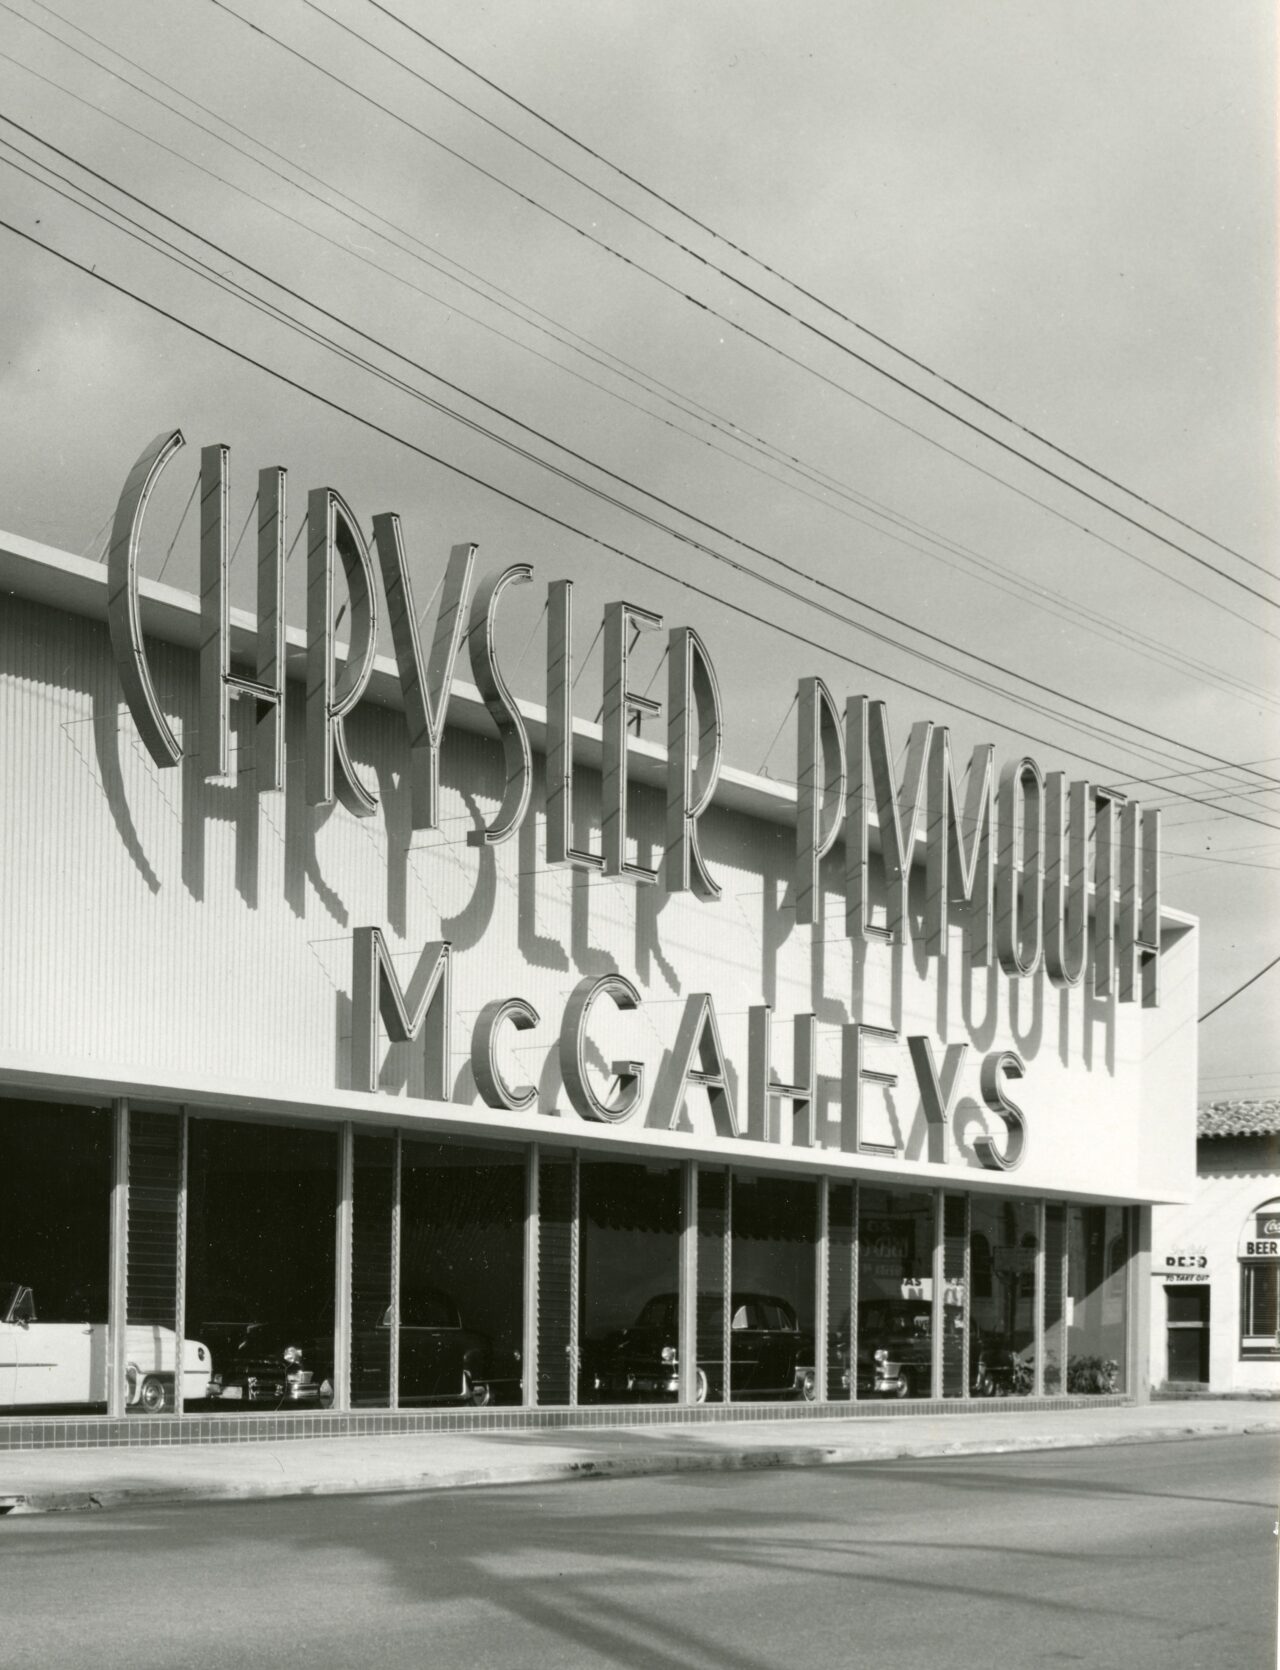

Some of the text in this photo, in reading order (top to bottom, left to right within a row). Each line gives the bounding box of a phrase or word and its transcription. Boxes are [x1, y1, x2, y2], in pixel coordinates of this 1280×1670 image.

[107, 428, 1161, 1009] CHRYSLER PLYMOUTH
[1246, 1241, 1277, 1254] BEER
